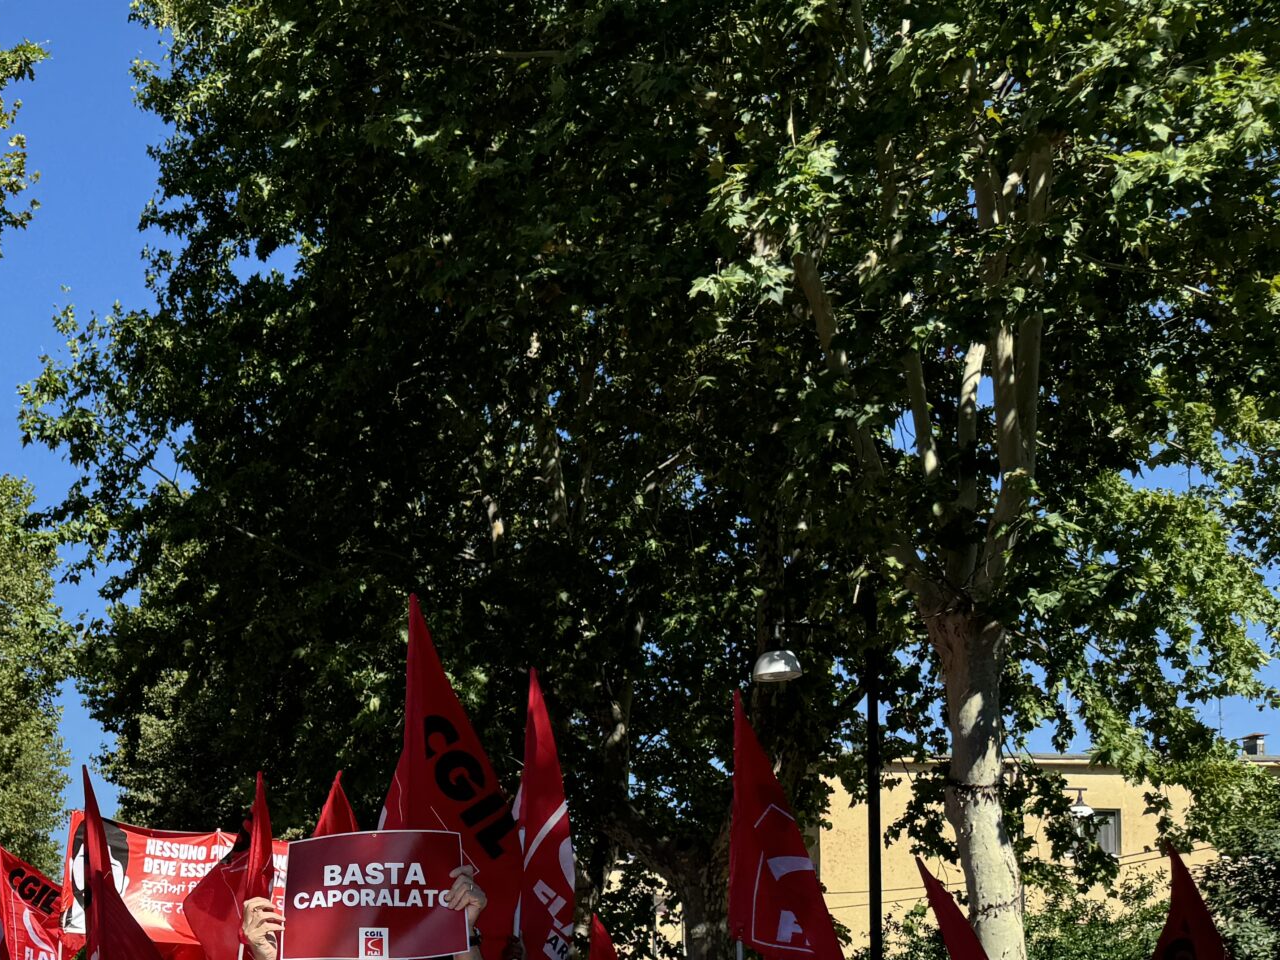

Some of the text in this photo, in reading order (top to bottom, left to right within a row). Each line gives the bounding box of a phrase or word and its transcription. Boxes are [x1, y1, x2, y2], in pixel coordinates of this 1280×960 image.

[146, 839, 207, 860] NESSUNO
[144, 858, 176, 876] DEVE
[323, 862, 426, 887] BASTA
[9, 867, 60, 915] CGIL
[293, 889, 452, 910] CAPORALATO
